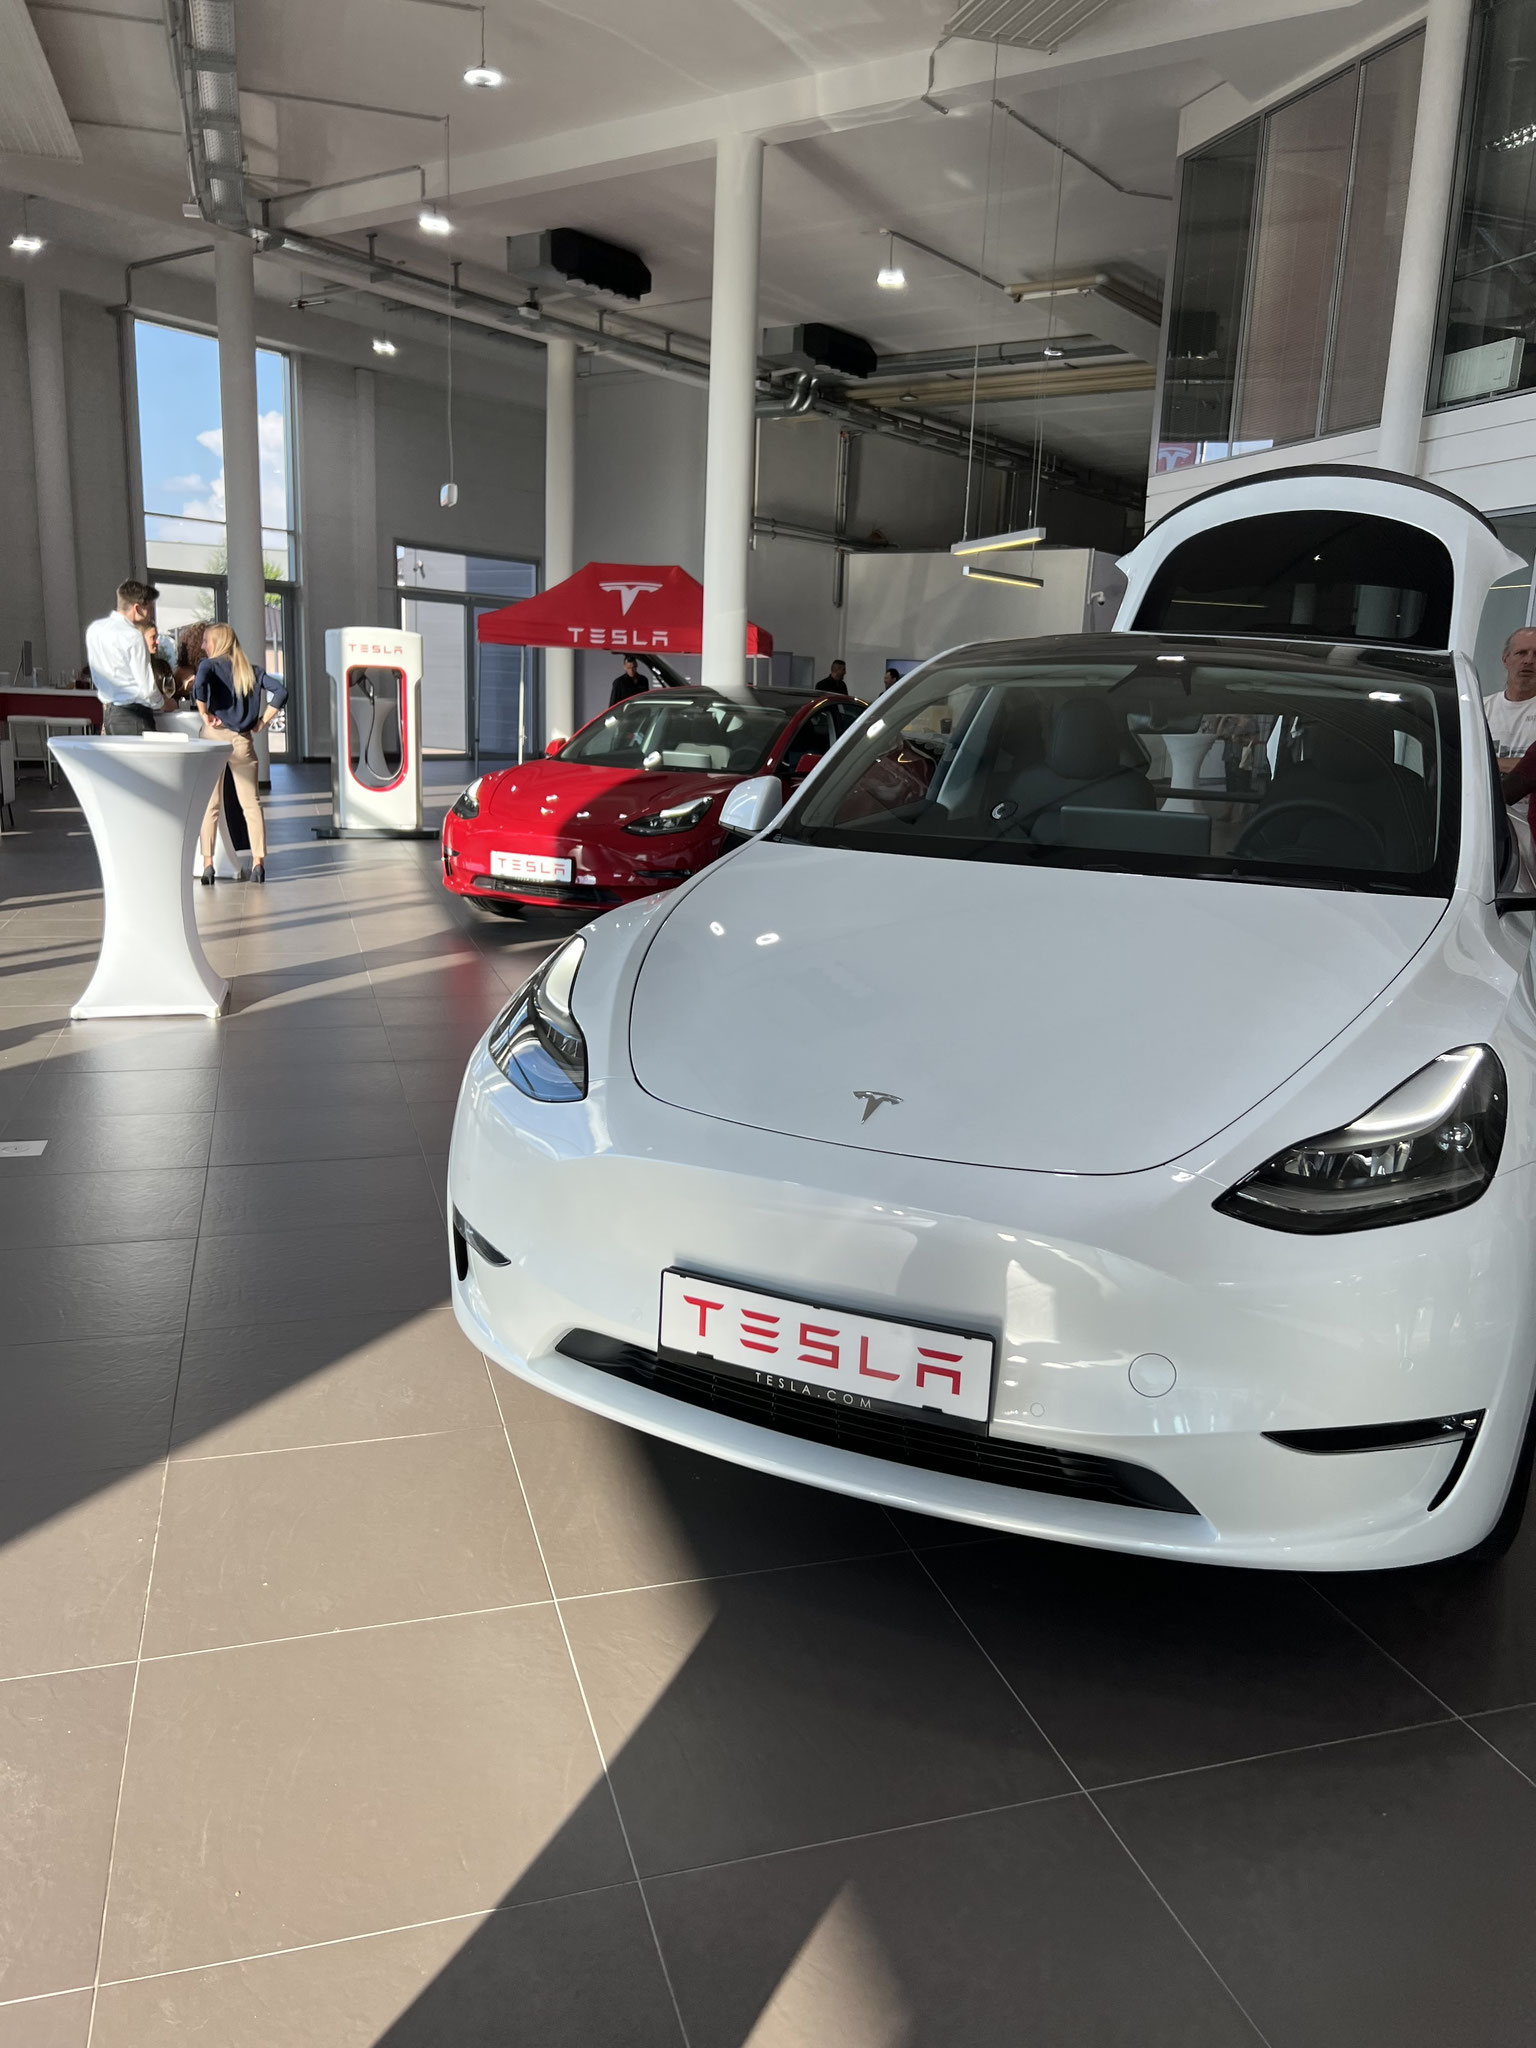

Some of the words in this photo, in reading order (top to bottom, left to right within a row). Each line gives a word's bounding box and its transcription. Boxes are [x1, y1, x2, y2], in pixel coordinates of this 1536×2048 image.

[567, 627, 669, 647] TESLA
[348, 643, 404, 655] TESLA
[497, 857, 566, 876] TESLA
[683, 1294, 964, 1396] TESLA
[755, 1371, 871, 1409] TESLA.COM
